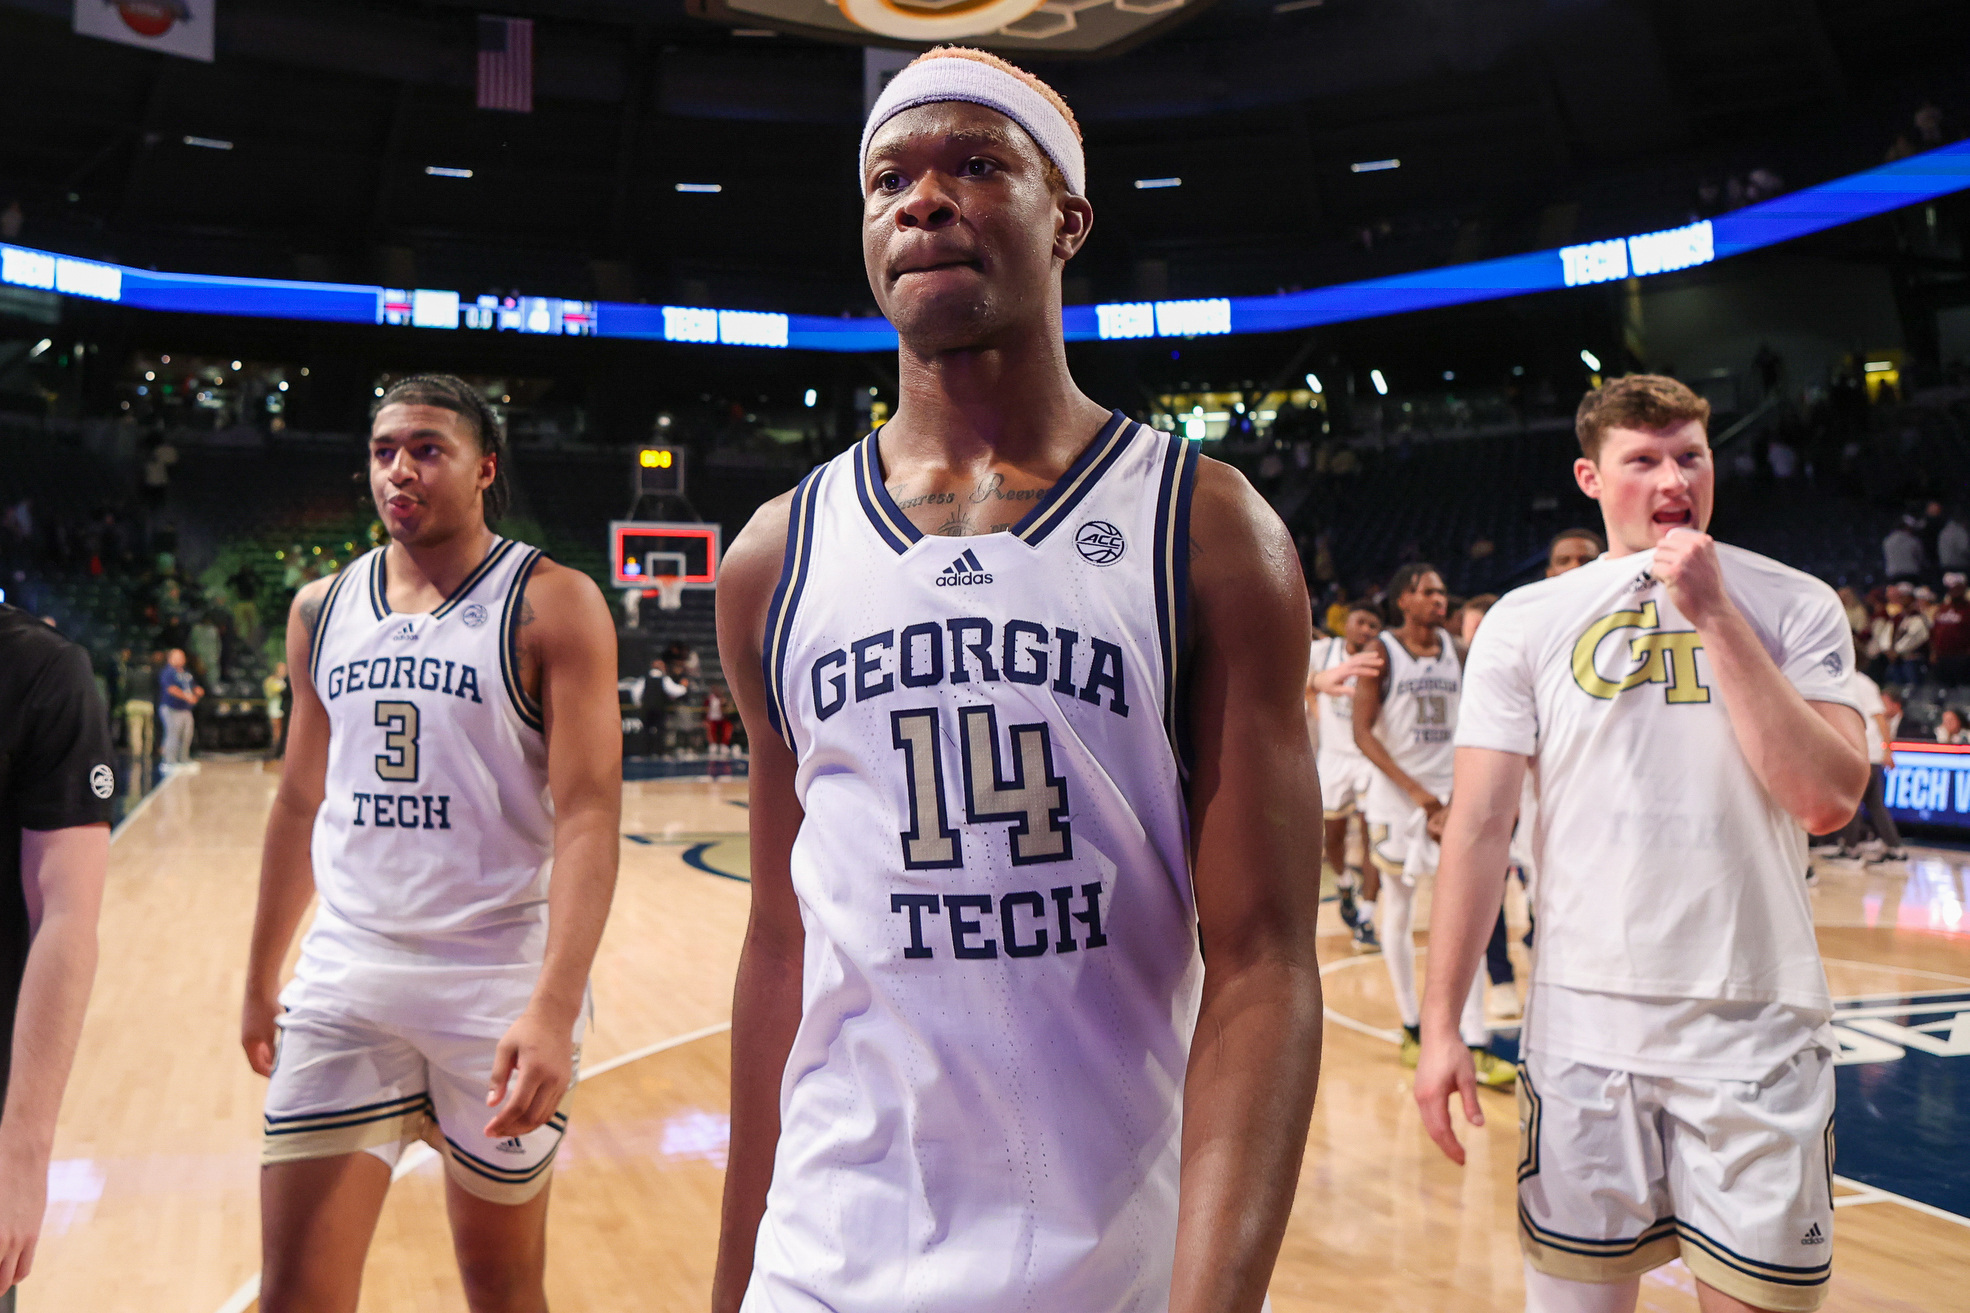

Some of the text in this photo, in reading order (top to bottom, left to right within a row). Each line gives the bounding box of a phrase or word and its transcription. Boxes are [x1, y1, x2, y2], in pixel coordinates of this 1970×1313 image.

[969, 473, 1052, 503] Reeve
[1081, 533, 1122, 547] ACC
[935, 572, 993, 587] adidas
[329, 656, 482, 704] GEORGIA
[810, 617, 1130, 721] GEORGIA
[374, 700, 420, 783] 3
[353, 792, 451, 829] TECH
[890, 704, 1073, 871] 14
[1884, 766, 1950, 812] TECH
[890, 882, 1108, 960] TECH
